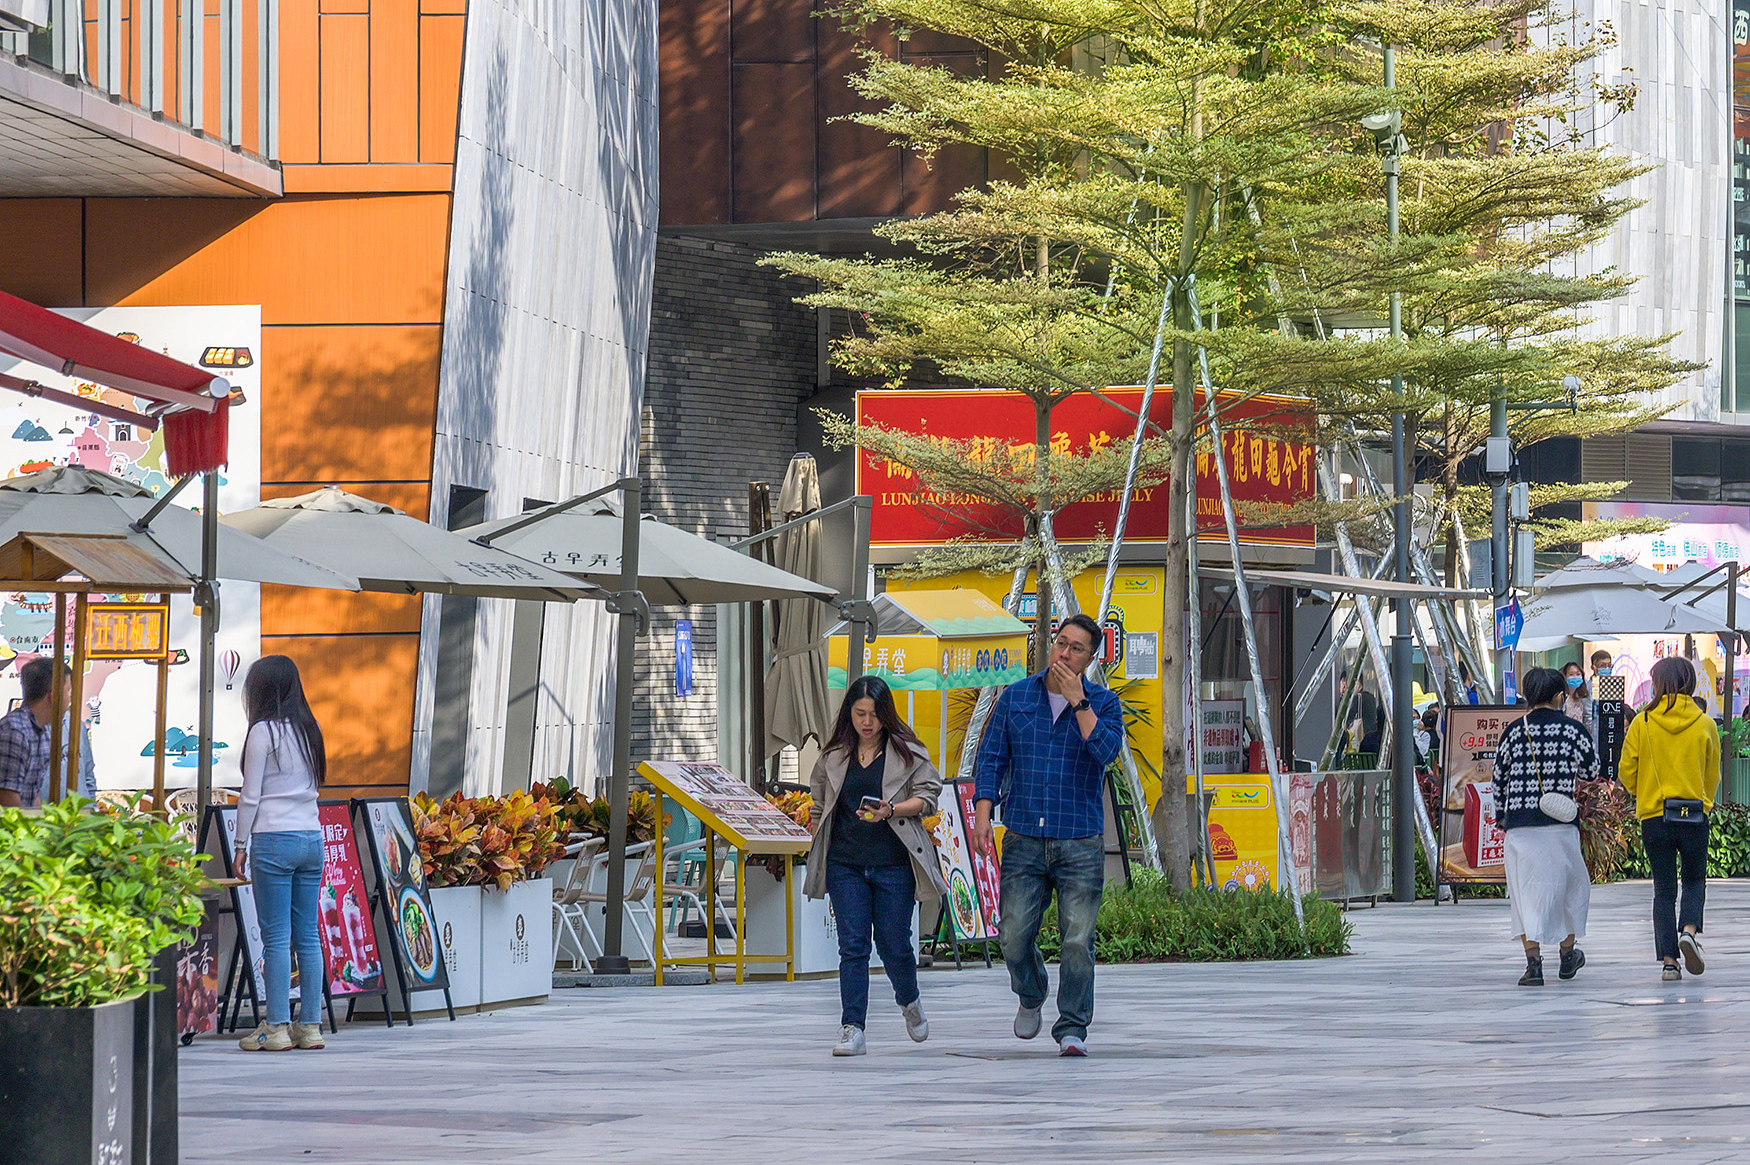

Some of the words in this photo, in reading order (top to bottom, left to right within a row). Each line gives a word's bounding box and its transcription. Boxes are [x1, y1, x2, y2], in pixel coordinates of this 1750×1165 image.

[541, 551, 624, 568] 古早弄
[1477, 718, 1499, 730] 购买
